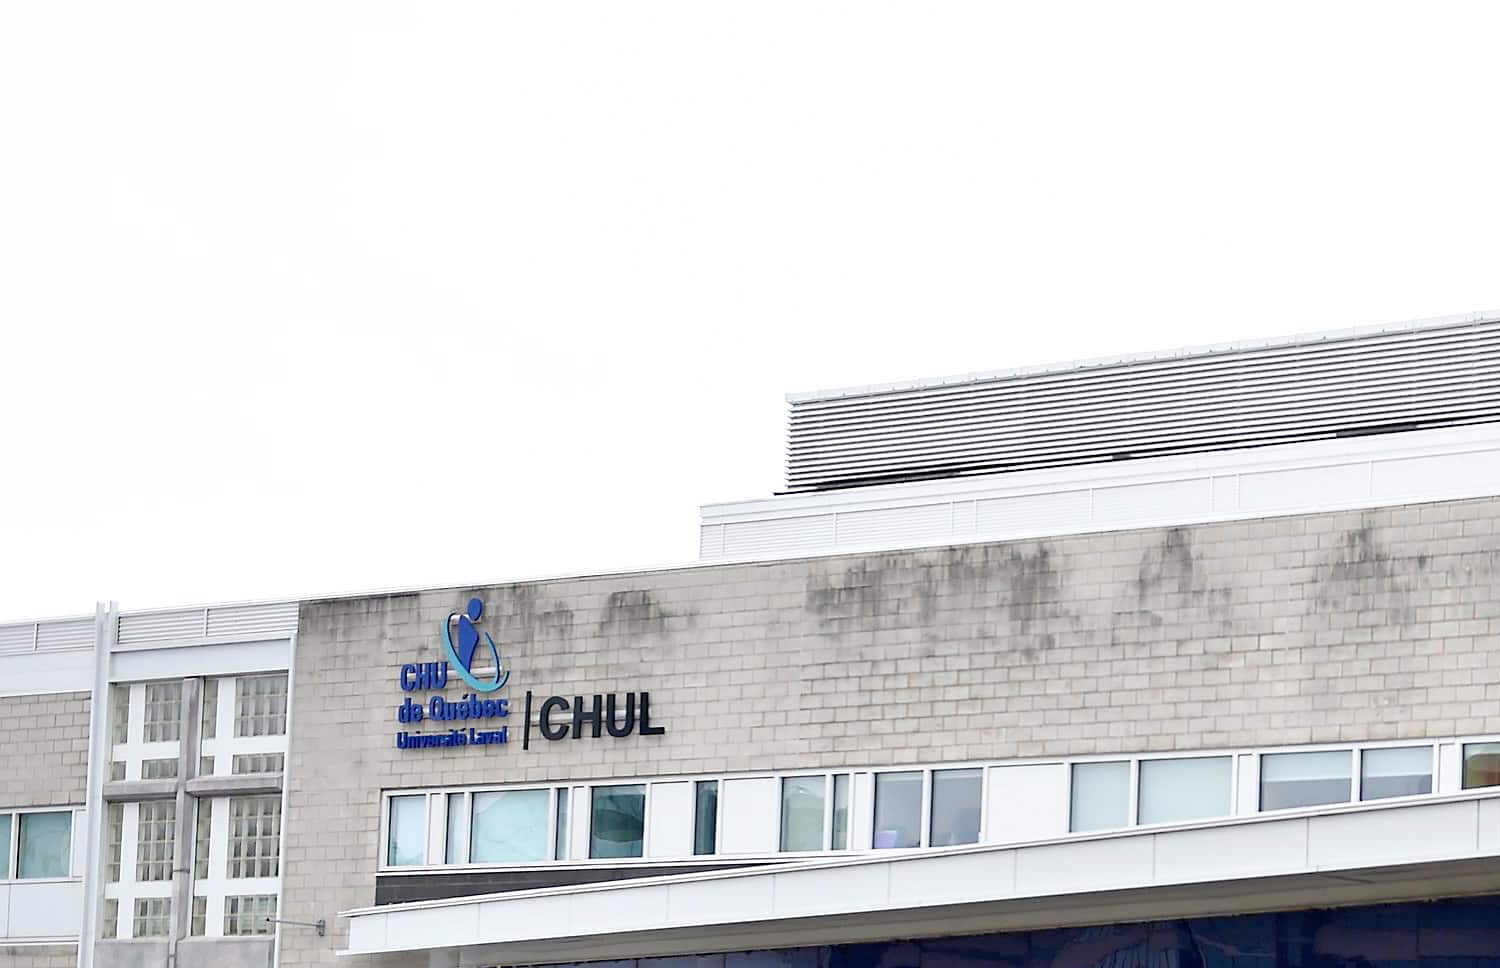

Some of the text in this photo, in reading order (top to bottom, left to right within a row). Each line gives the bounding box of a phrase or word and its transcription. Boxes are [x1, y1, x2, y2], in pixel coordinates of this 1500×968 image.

[400, 661, 448, 692] CHU
[399, 693, 509, 723] de Québec
[539, 691, 666, 741] CHUL
[396, 725, 508, 749] Université Laval
